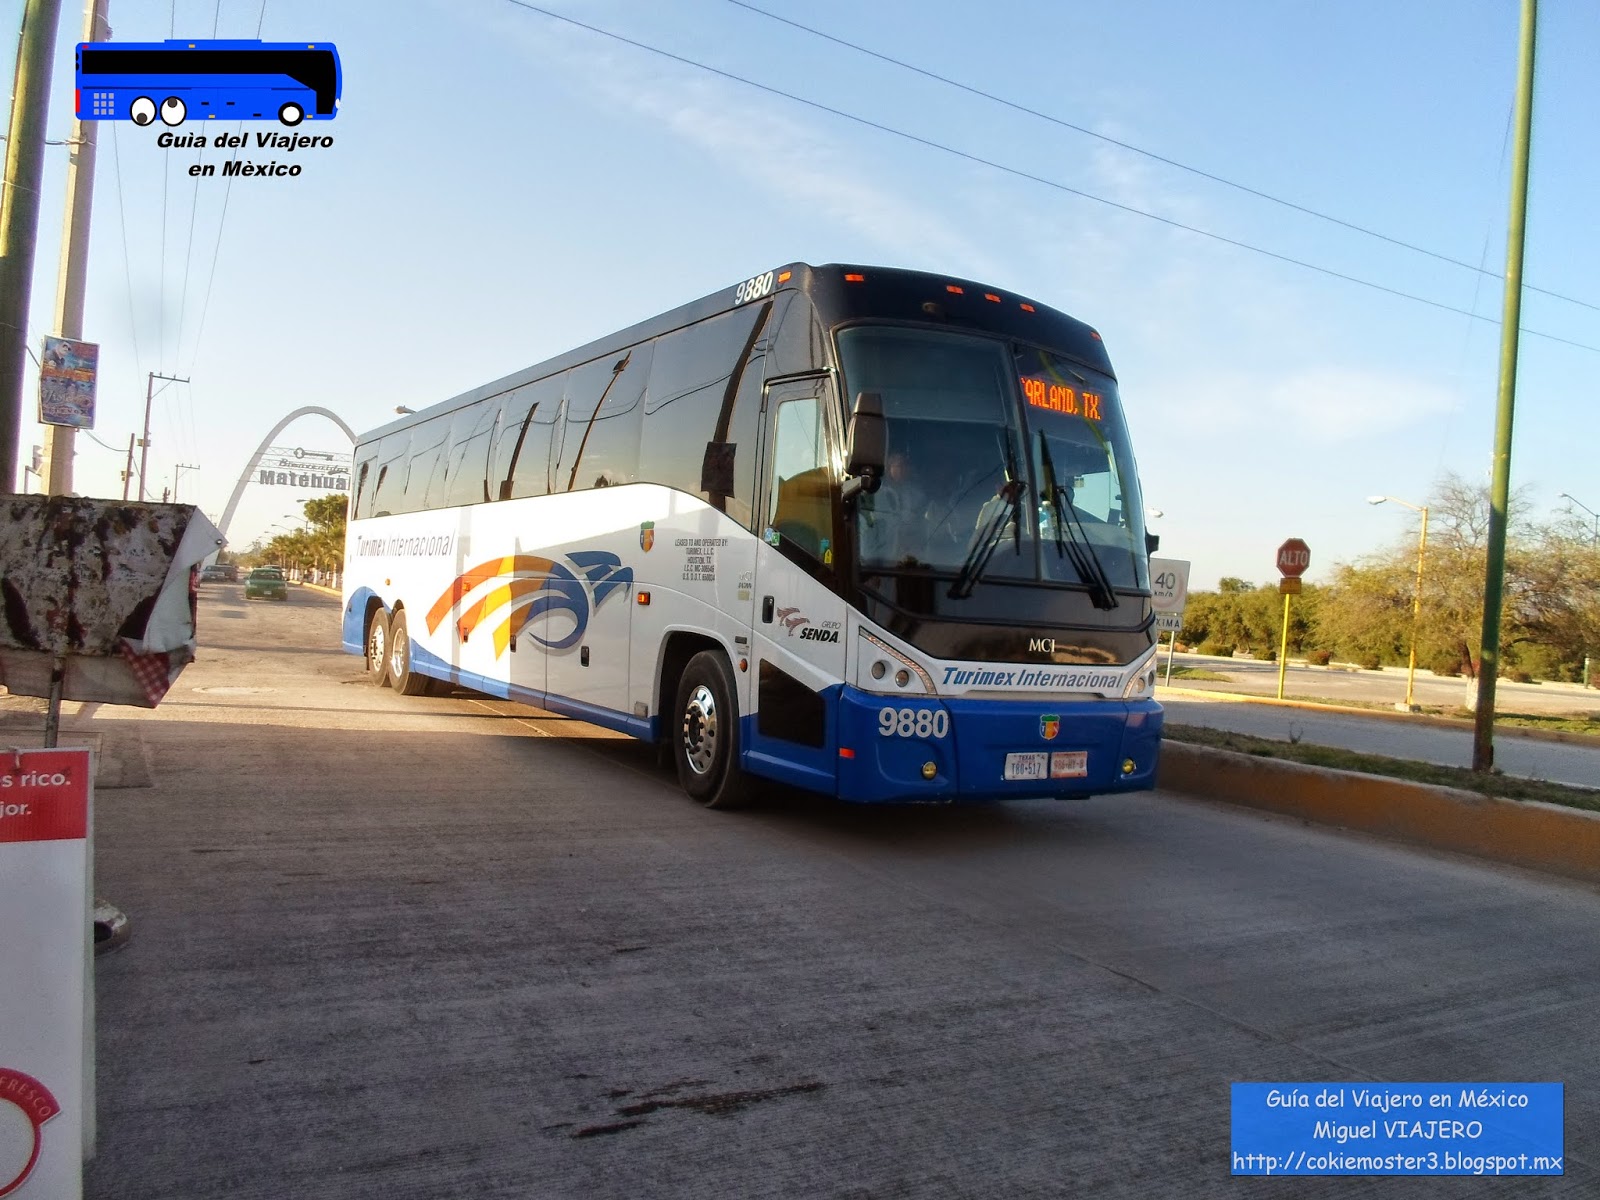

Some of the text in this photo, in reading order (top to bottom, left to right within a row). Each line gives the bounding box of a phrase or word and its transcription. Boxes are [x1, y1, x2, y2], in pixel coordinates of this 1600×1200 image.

[735, 271, 774, 305] 9880
[1021, 377, 1079, 415] ARLAND,
[356, 528, 456, 557] Turimex Internacional
[1279, 552, 1309, 566] ALTO
[1155, 572, 1176, 590] 40
[822, 620, 842, 630] GRUPO
[1156, 618, 1181, 628] XIMA
[800, 627, 840, 643] SENDA
[1029, 638, 1055, 653] MCI
[942, 667, 1123, 689] Turimex Internacional
[878, 707, 949, 738] 9880
[21, 771, 71, 787] rico.
